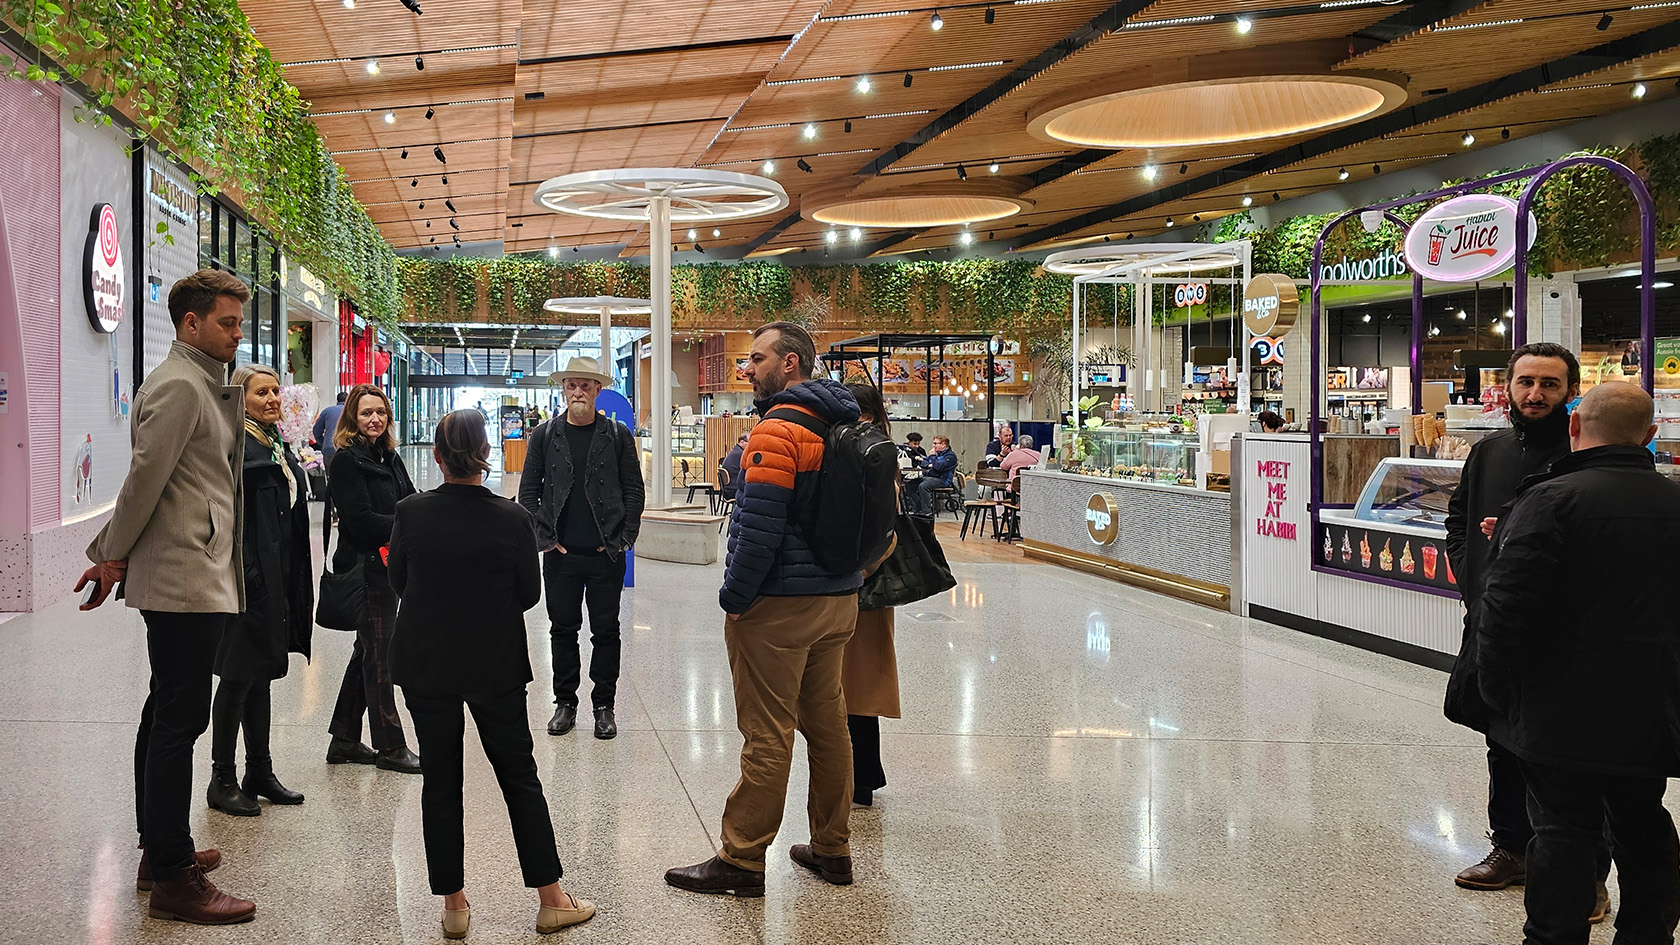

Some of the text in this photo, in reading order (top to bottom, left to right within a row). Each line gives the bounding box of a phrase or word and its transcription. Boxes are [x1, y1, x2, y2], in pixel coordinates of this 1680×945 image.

[1450, 223, 1500, 254] Juice
[92, 269, 122, 305] Candy
[1177, 285, 1205, 303] BWS
[1244, 296, 1278, 312] BAKED
[1257, 460, 1291, 479] MEET
[1267, 481, 1287, 500] ME
[1085, 508, 1111, 526] BAKED
[1265, 500, 1283, 518] AT
[1257, 518, 1297, 540] HABIBI
